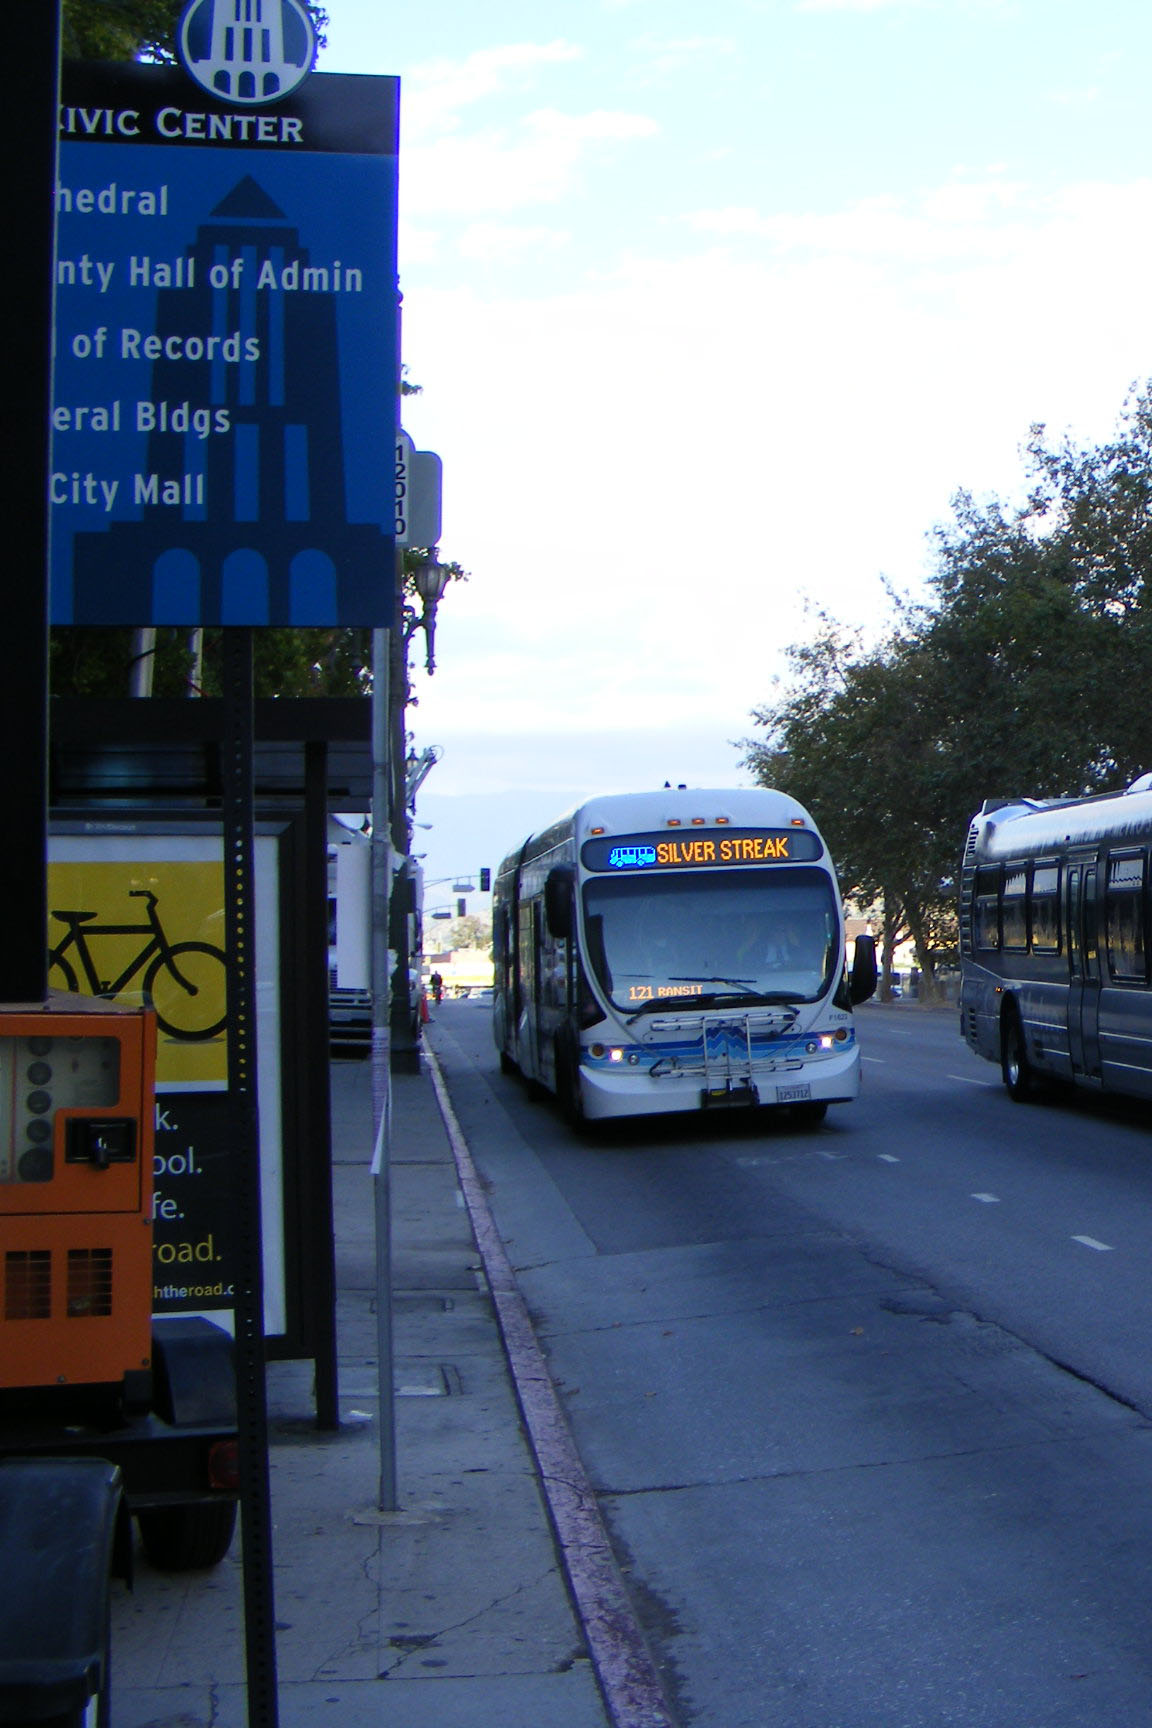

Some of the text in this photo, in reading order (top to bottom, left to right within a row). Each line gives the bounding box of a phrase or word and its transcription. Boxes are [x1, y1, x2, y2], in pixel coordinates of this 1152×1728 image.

[57, 103, 304, 142] IVIC CENTER
[56, 181, 168, 215] hedral
[57, 254, 362, 293] nty Hall of Admin
[72, 327, 107, 359] of
[121, 328, 260, 363] Records
[52, 400, 231, 440] eral Bldgs
[50, 472, 204, 512] City Mall
[656, 836, 790, 864] SILVER STREAK
[629, 983, 704, 1000] 121 RANSIT
[152, 1233, 222, 1263] oad.
